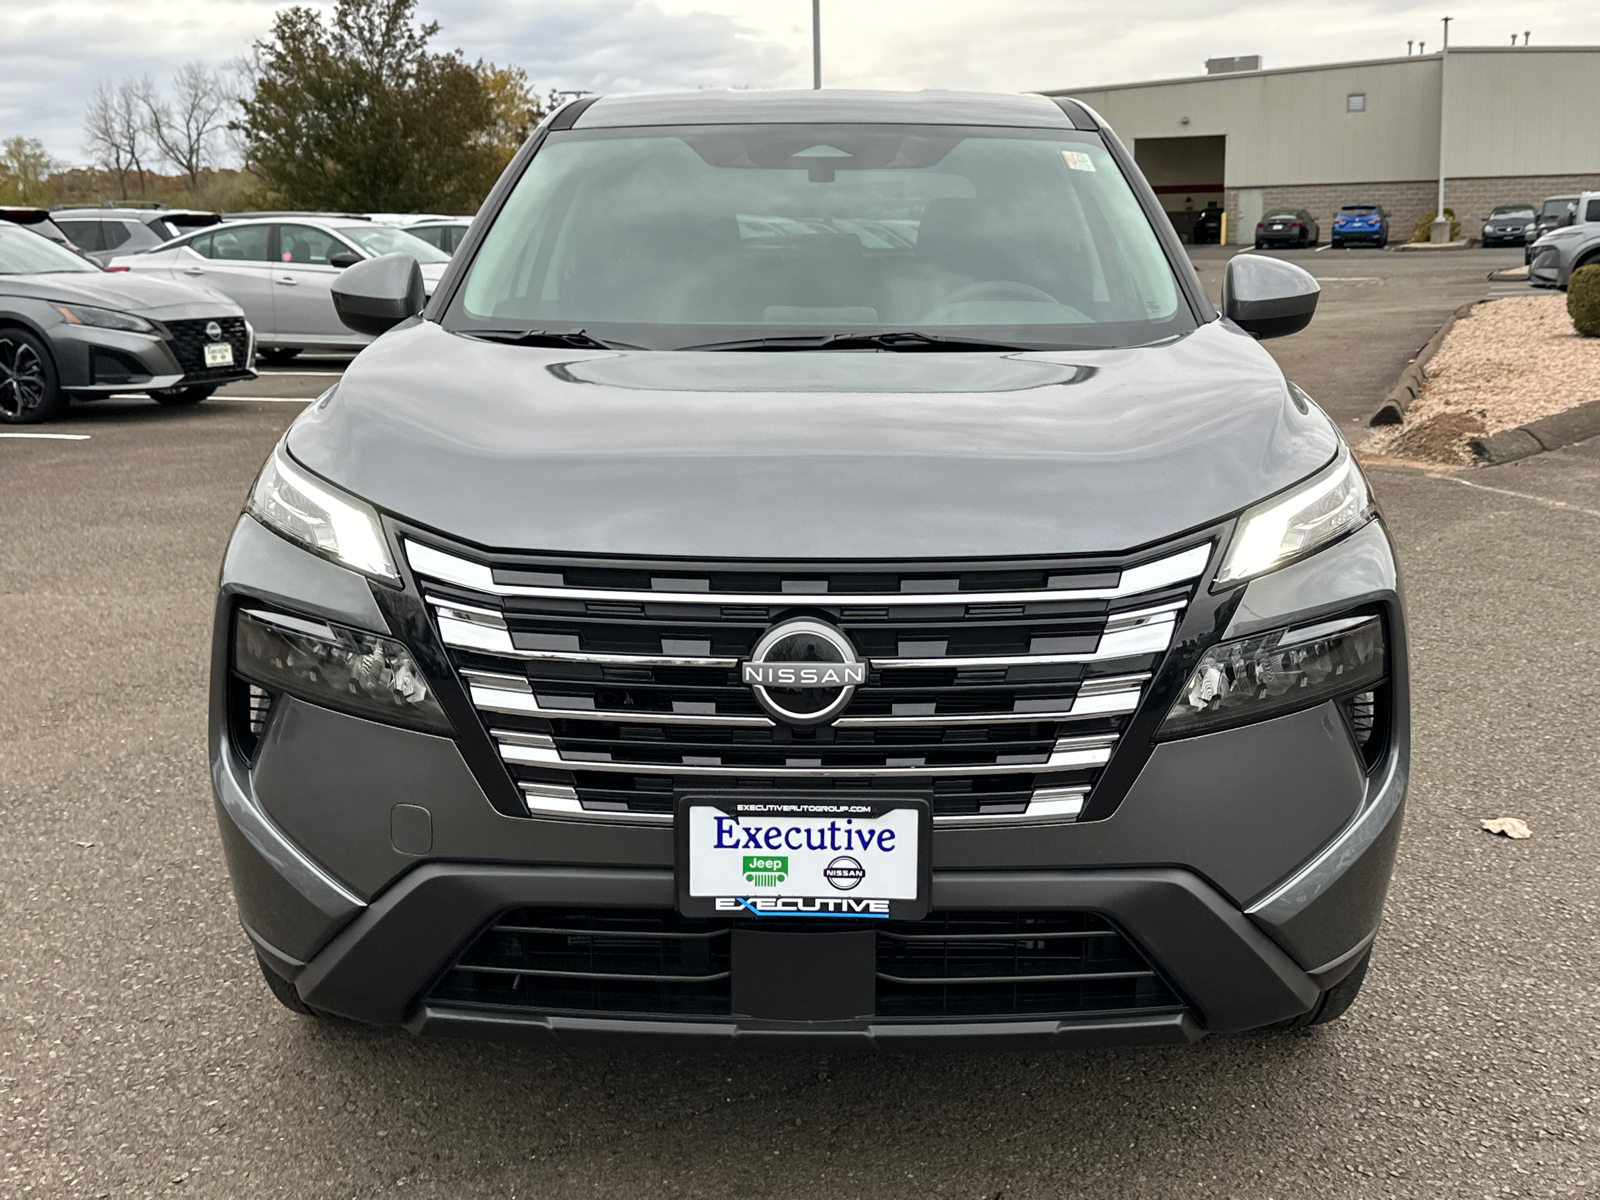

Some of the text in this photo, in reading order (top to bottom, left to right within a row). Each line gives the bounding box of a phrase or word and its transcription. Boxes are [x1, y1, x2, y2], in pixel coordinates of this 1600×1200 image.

[745, 666, 862, 684] NISSAN
[736, 804, 871, 813] EXECUTIVEAUTOGROUP.COM
[713, 816, 896, 852] Executive
[749, 857, 782, 871] Jeep
[825, 869, 863, 878] NISSAN
[715, 897, 890, 913] EXECUTIVE
